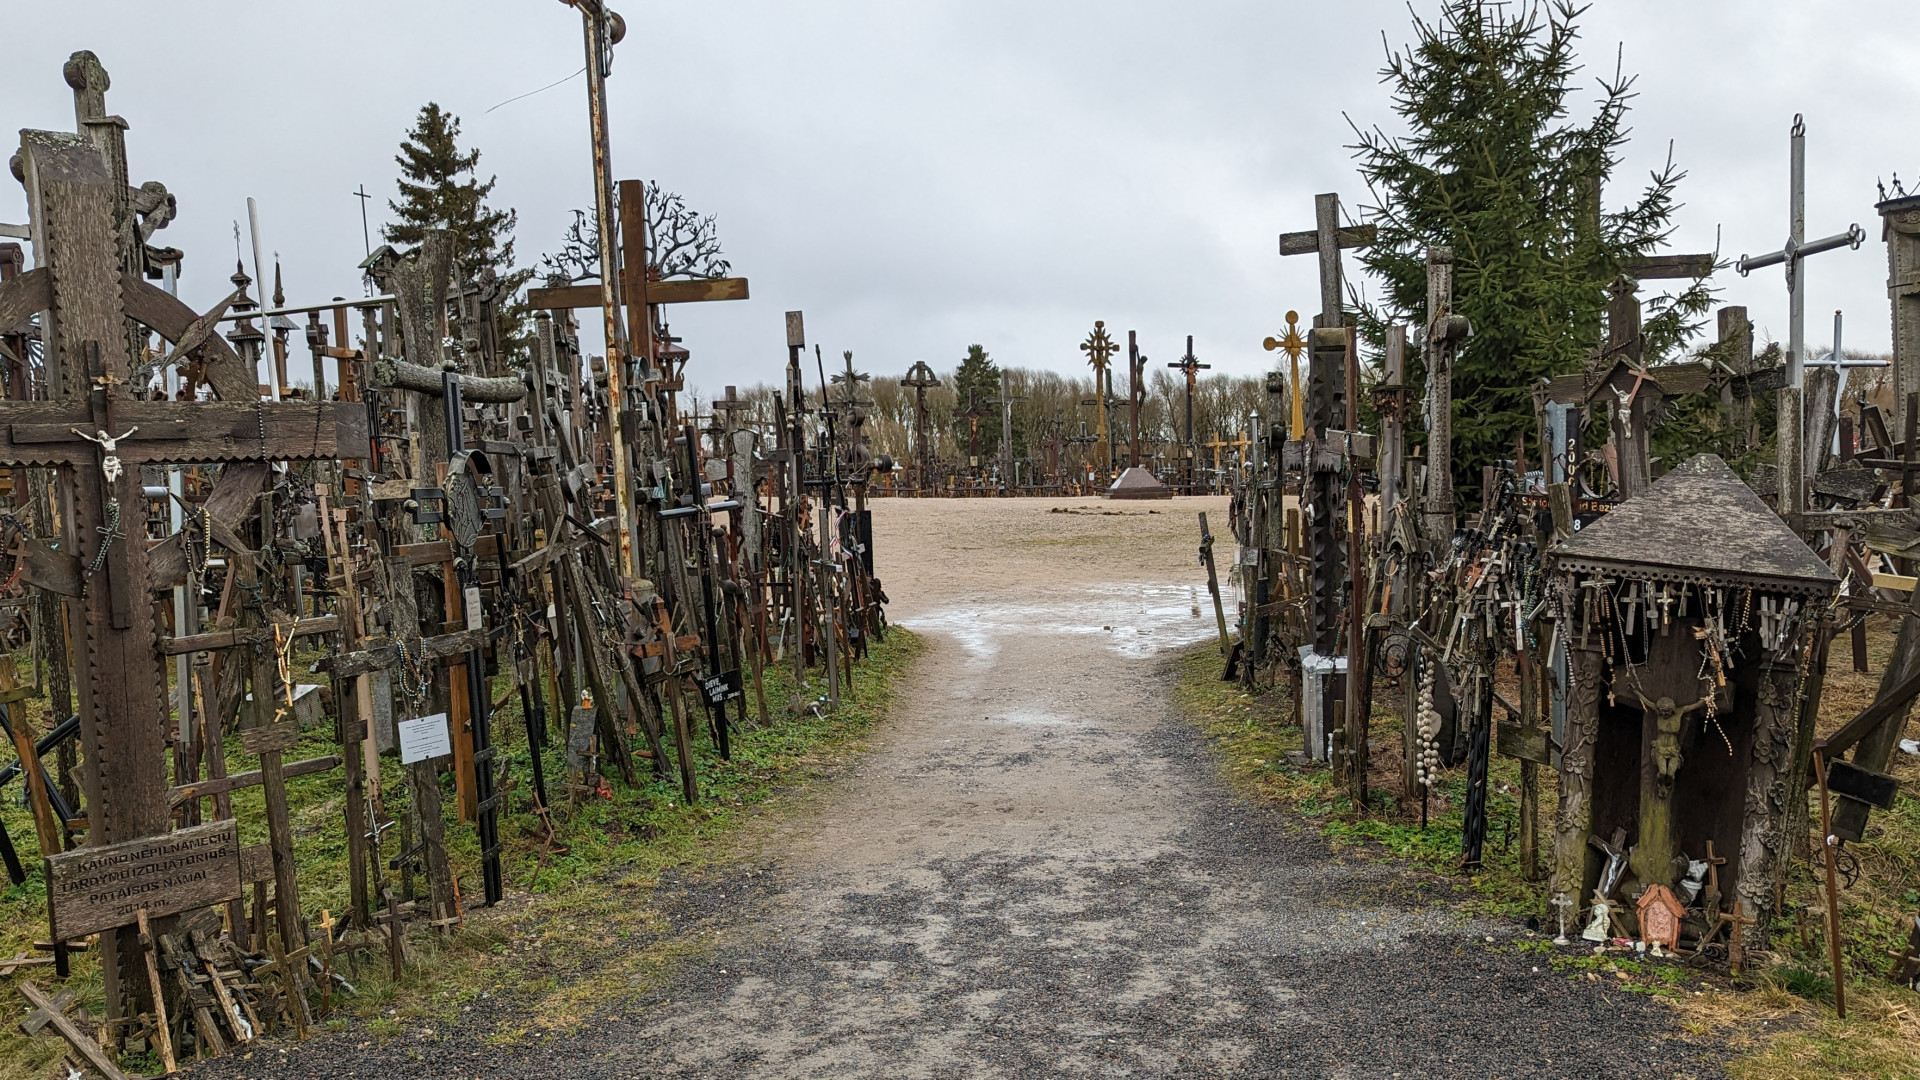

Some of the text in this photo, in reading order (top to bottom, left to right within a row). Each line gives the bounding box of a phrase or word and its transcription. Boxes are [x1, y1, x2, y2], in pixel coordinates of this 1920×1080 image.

[77, 854, 128, 873] KAUNO
[61, 871, 129, 892] TARDYMO
[90, 870, 206, 904] PATAISOS NAMAI
